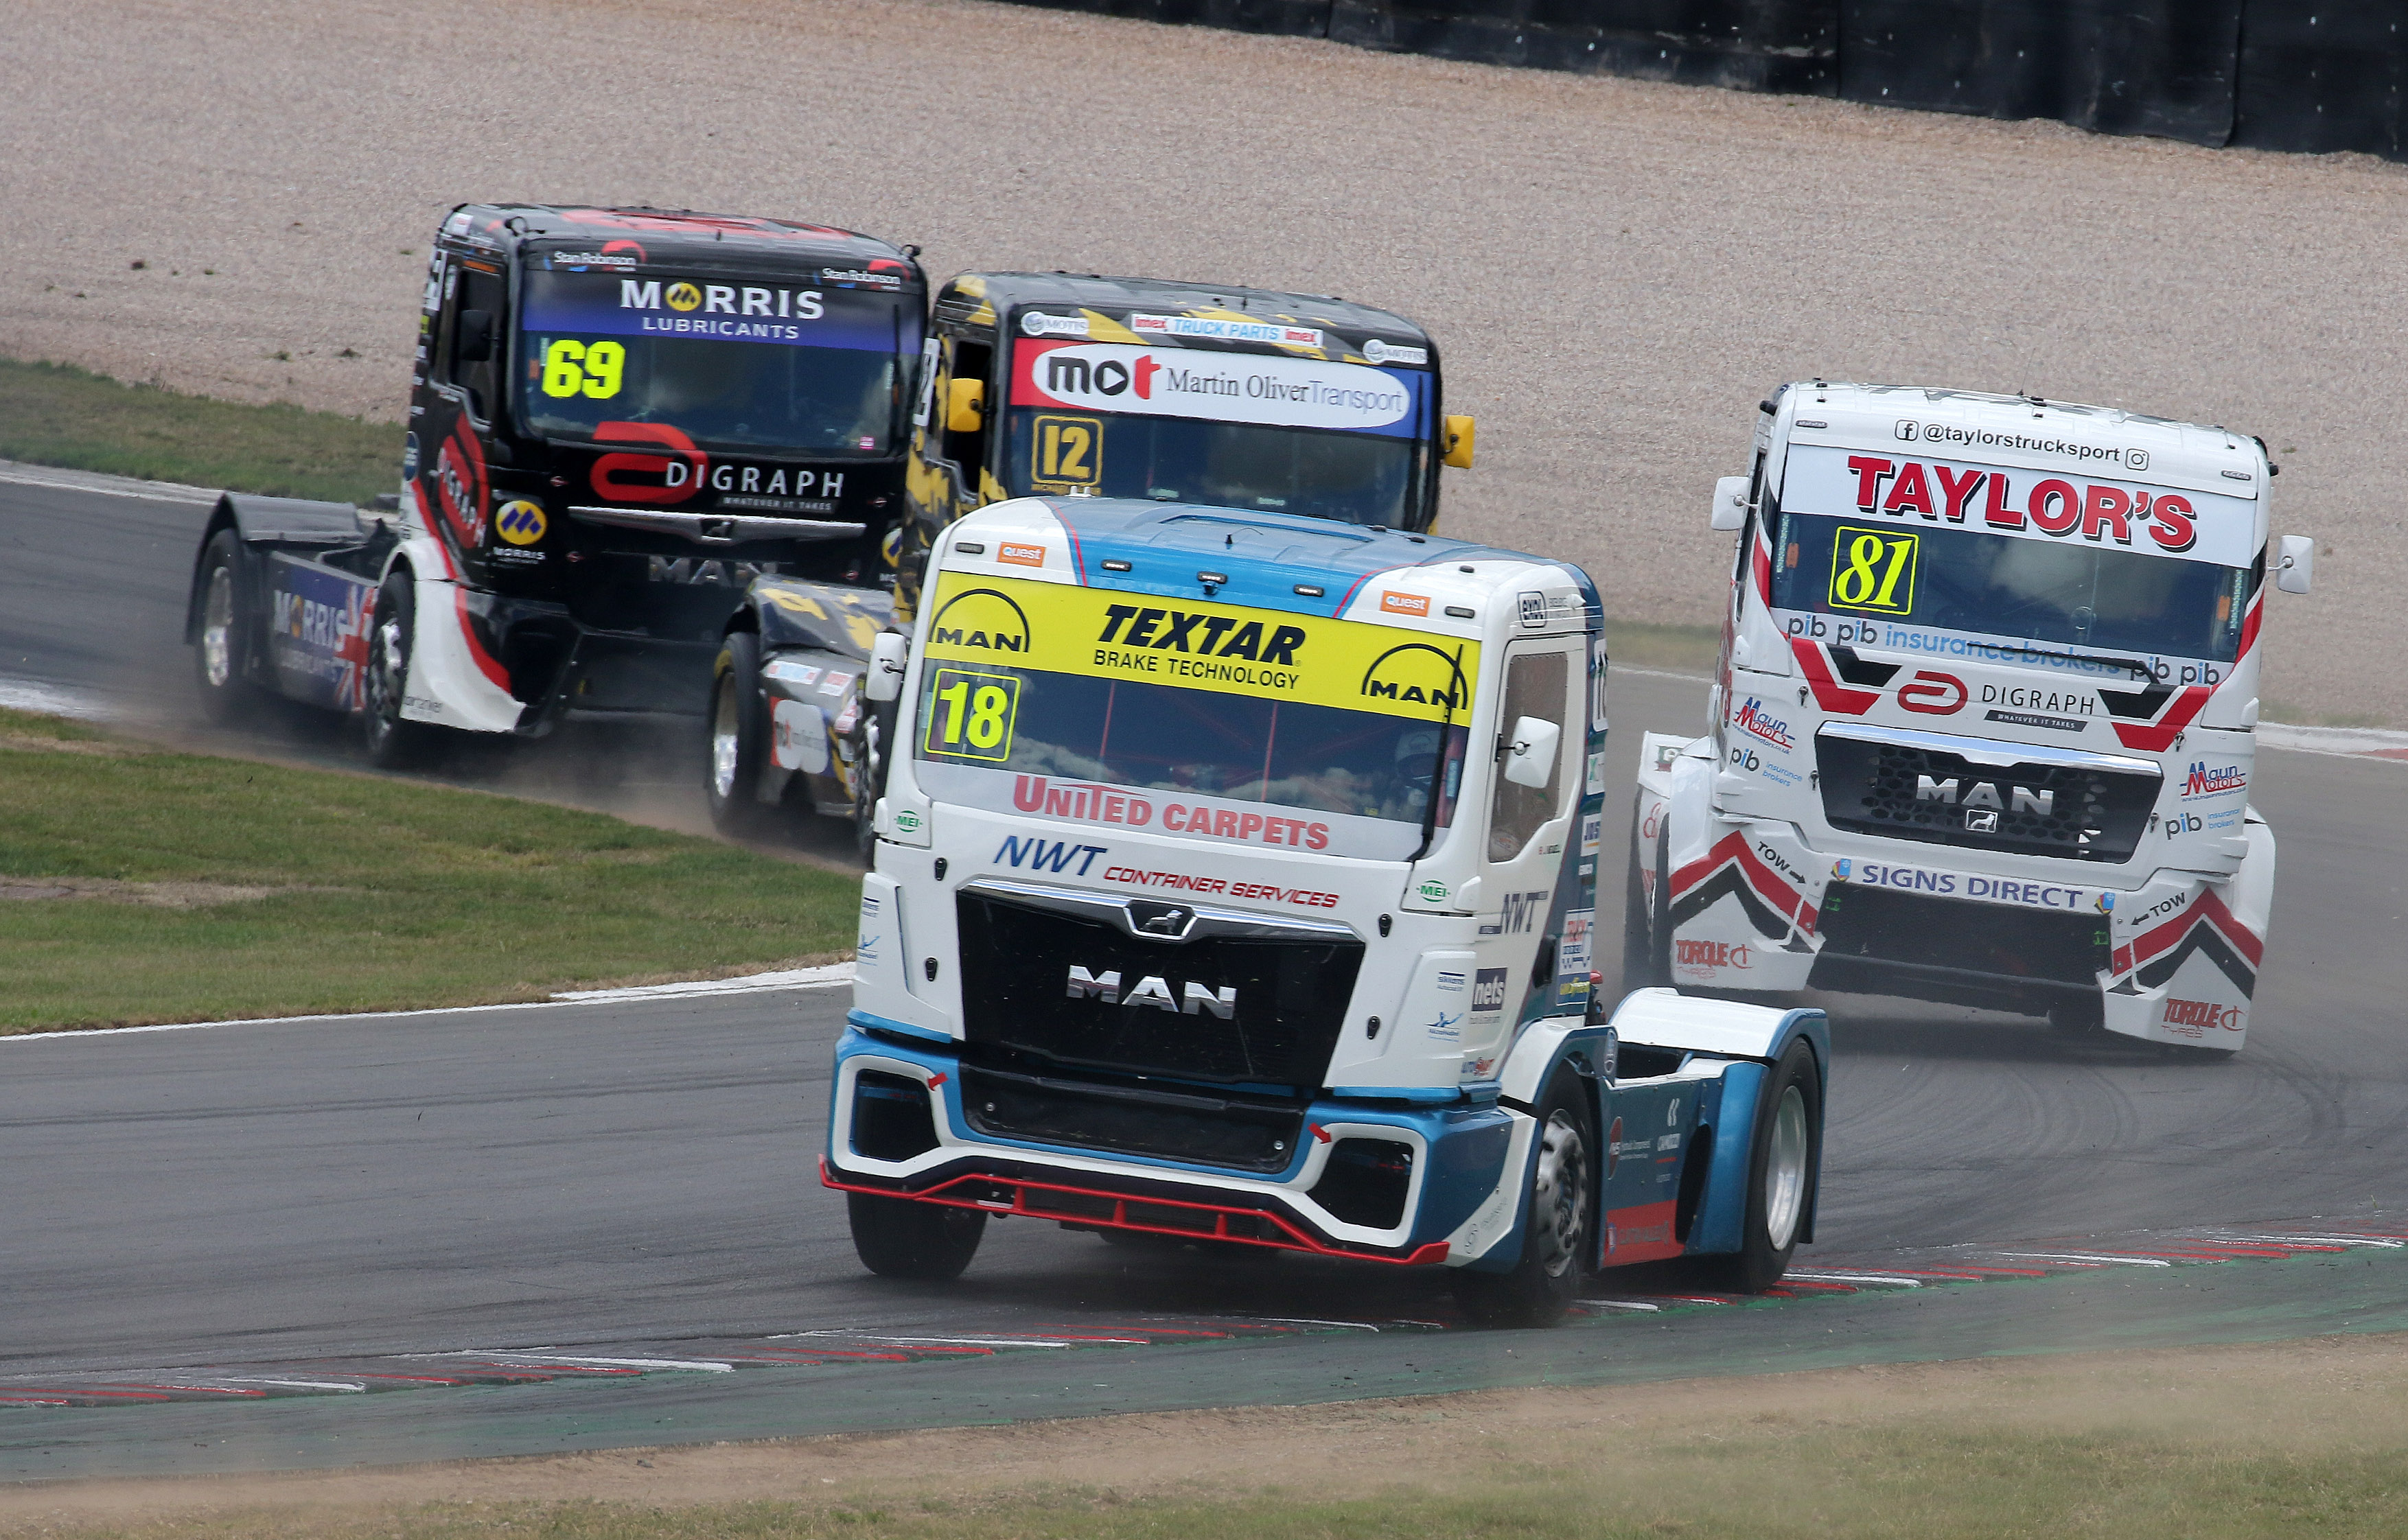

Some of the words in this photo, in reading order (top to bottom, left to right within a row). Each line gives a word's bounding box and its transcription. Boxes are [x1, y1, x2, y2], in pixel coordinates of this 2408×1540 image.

[620, 279, 824, 320] MORRIS
[642, 316, 799, 340] LUBRICANTS
[1173, 319, 1226, 335] TRUCK
[1231, 325, 1280, 340] PARTS
[541, 339, 625, 399] 69
[1167, 366, 1240, 397] Martin
[1043, 425, 1091, 479] 12
[1923, 423, 2120, 462] @taylorstrucksport
[665, 462, 844, 498] DIGRAPH
[798, 502, 833, 511] TAKES
[1848, 456, 2198, 553] TAYLOR'S
[1836, 534, 1913, 607] 81
[937, 627, 1022, 652] MAN
[1097, 603, 1306, 666] TEXTAR
[1788, 614, 1827, 638] pib
[1837, 620, 1877, 645] pib
[1885, 625, 2014, 661] insurance
[2181, 662, 2219, 686] pib
[1093, 649, 1159, 673] BRAKE
[1168, 657, 1300, 690] TECHNOLOGY
[1370, 679, 1459, 709] MAN
[1982, 684, 2095, 715] DIGRAPH
[939, 681, 1009, 749] 18
[1733, 705, 1790, 749] Motors
[1735, 696, 1790, 736] Maun
[1998, 713, 2038, 724] WHATEVER
[2052, 720, 2075, 729] TAKES
[1729, 747, 1760, 772] pib
[1766, 760, 1803, 782] insurance
[2180, 761, 2243, 786] Maun
[1762, 770, 1791, 787] brokers
[2181, 771, 2245, 796] Motors
[1916, 774, 2054, 815] MAN
[896, 815, 921, 828] MEI
[1163, 803, 1329, 850] CARPETS
[2165, 812, 2203, 841] pib
[993, 835, 1108, 876] NWT
[1104, 867, 1227, 894] CONTAINER
[1230, 882, 1340, 909] SERVICES
[1757, 841, 1791, 872] TOW
[1420, 885, 1447, 898] MEI
[1862, 865, 1956, 894] SIGNS
[1968, 877, 2083, 908] DIRECT
[2149, 891, 2186, 918] TOW
[1676, 939, 1729, 968] TORQUE
[1066, 964, 1237, 1020] MAN
[1473, 975, 1505, 1005] nets
[2164, 998, 2222, 1029] TORQUE
